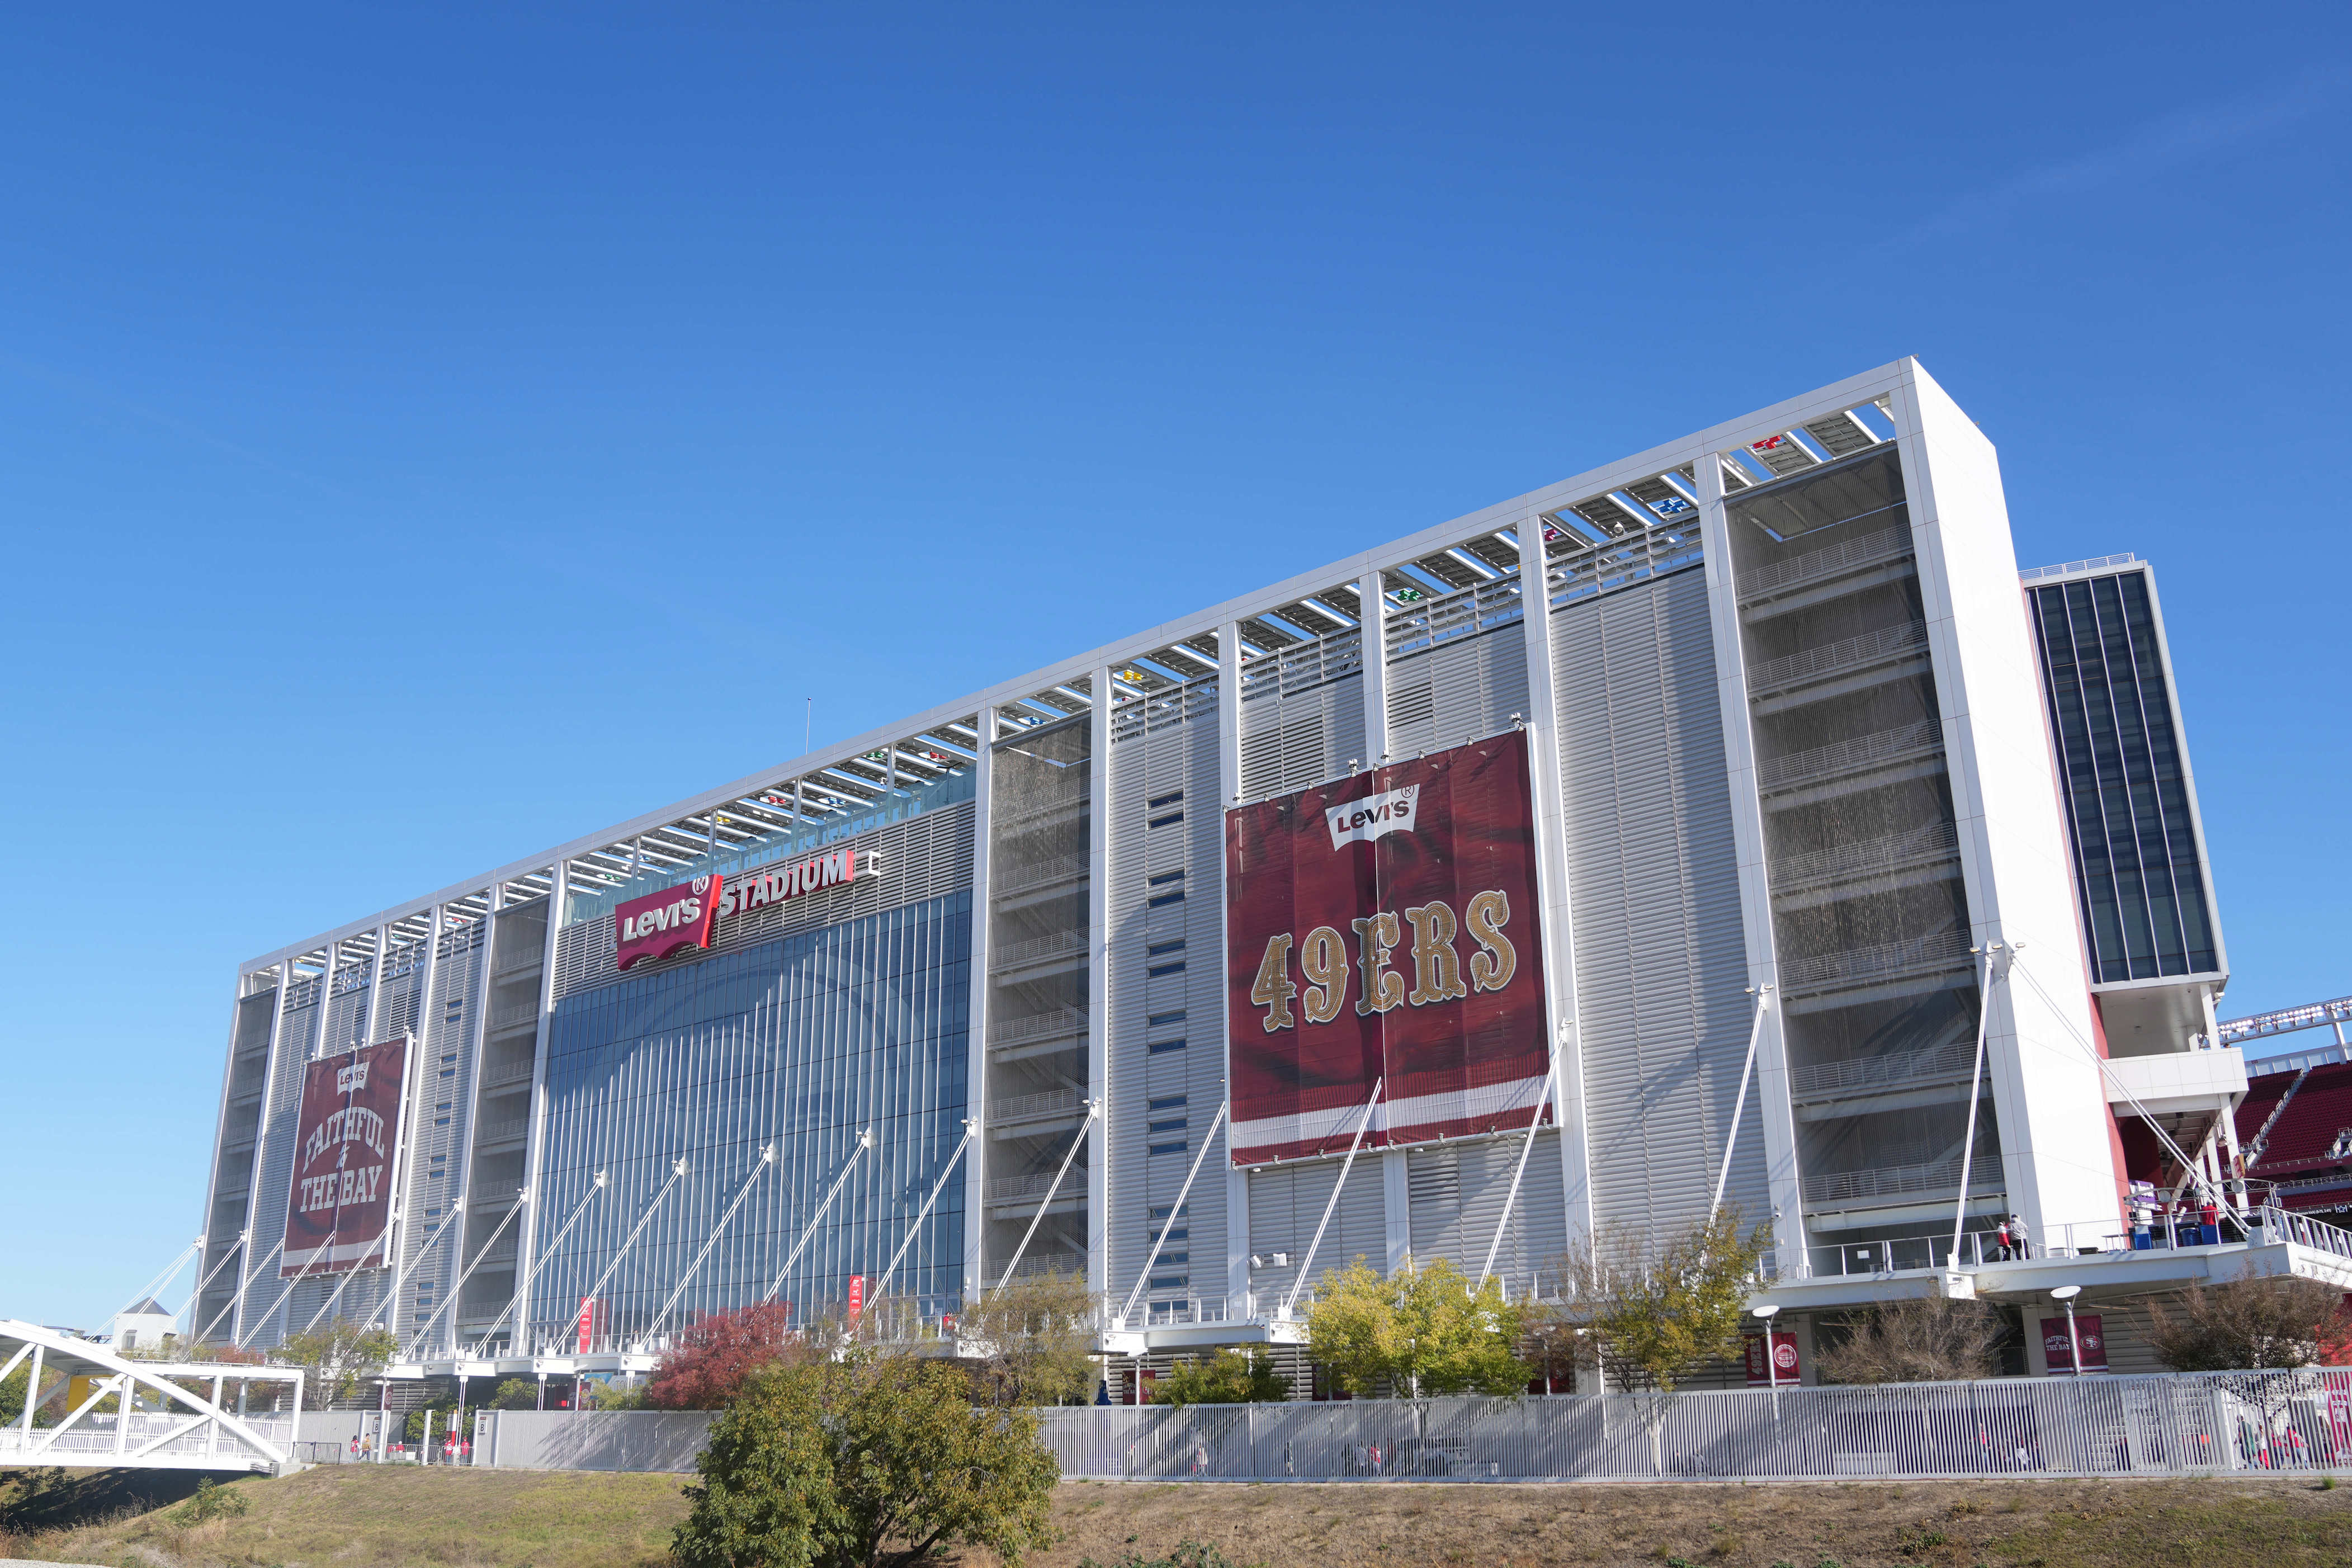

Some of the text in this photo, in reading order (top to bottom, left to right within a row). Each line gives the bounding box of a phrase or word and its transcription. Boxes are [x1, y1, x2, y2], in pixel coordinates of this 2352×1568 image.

[721, 849, 849, 917] STADIUM
[1250, 889, 1517, 1033] 49ERS
[303, 1106, 385, 1174] FAITHFUL
[300, 1165, 383, 1213] THE BAY
[2045, 1335, 2070, 1345] FAITHFUL
